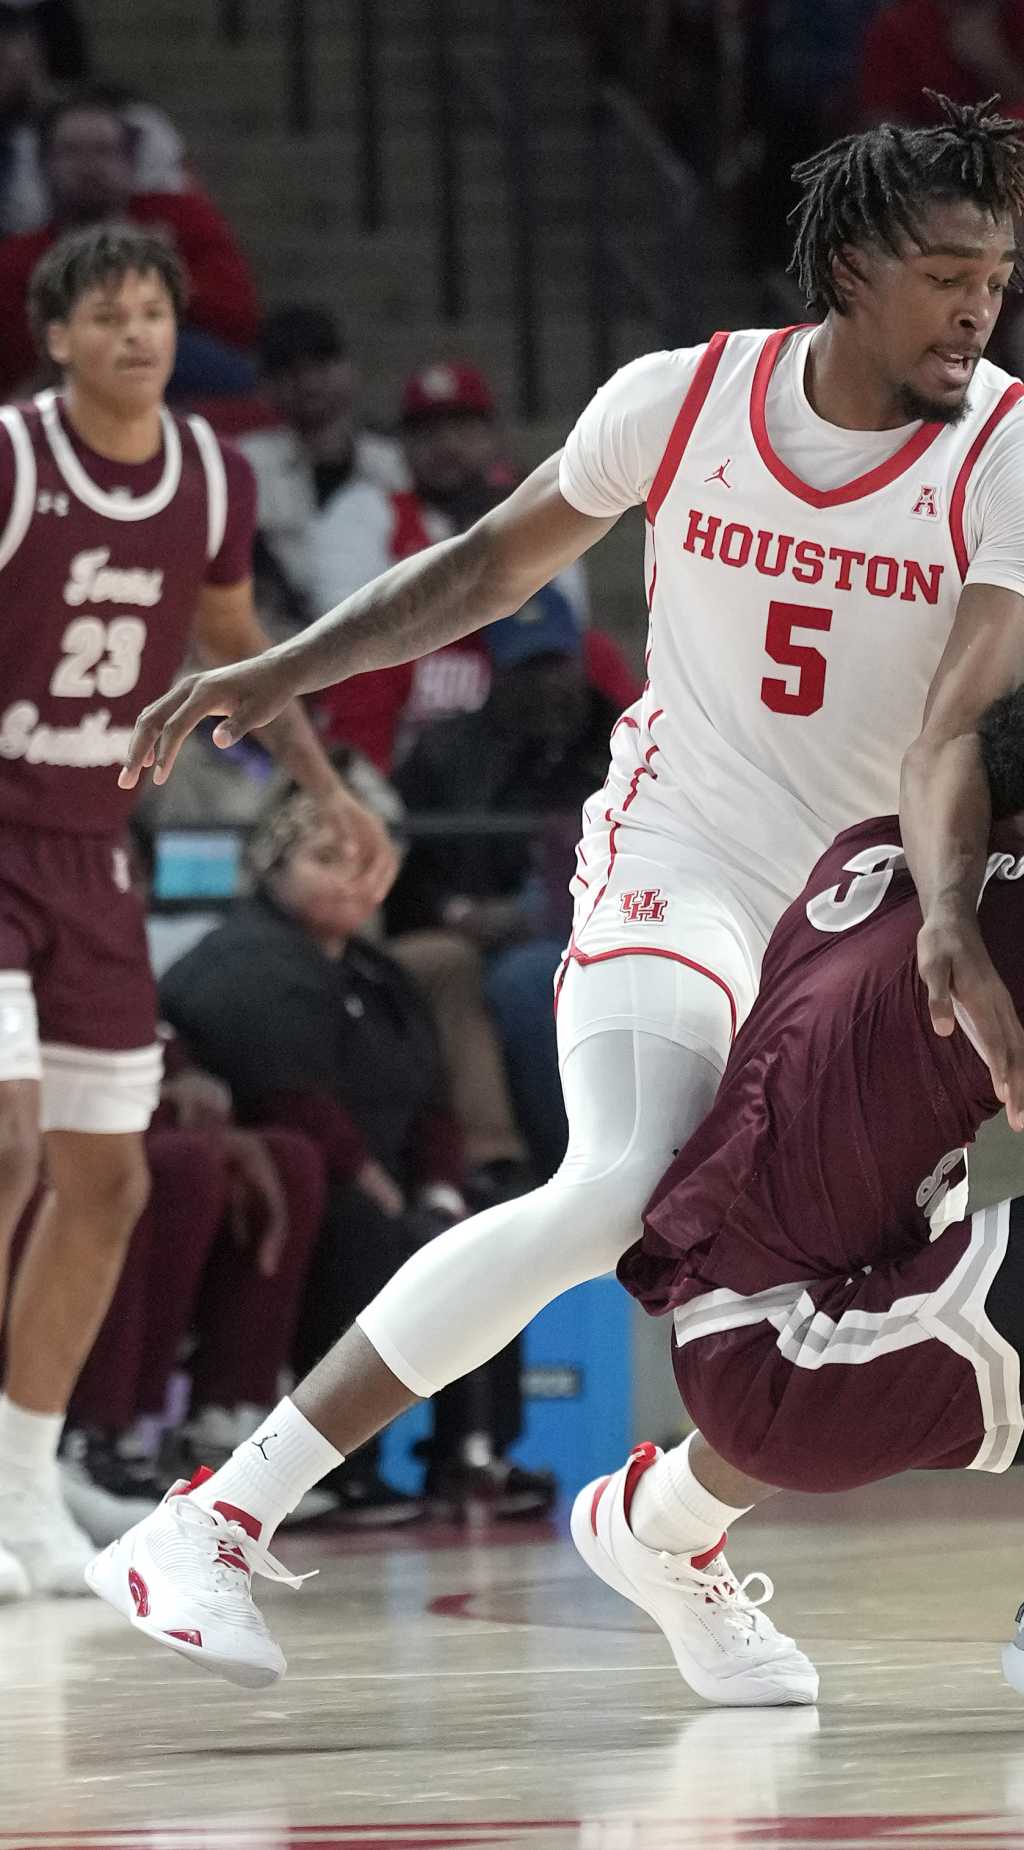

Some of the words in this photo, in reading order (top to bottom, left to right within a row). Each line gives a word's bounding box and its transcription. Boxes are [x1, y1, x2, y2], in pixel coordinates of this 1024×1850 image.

[683, 509, 944, 605] HOUSTON
[51, 615, 147, 698] 23
[760, 600, 833, 717] 5
[806, 844, 905, 932] 3
